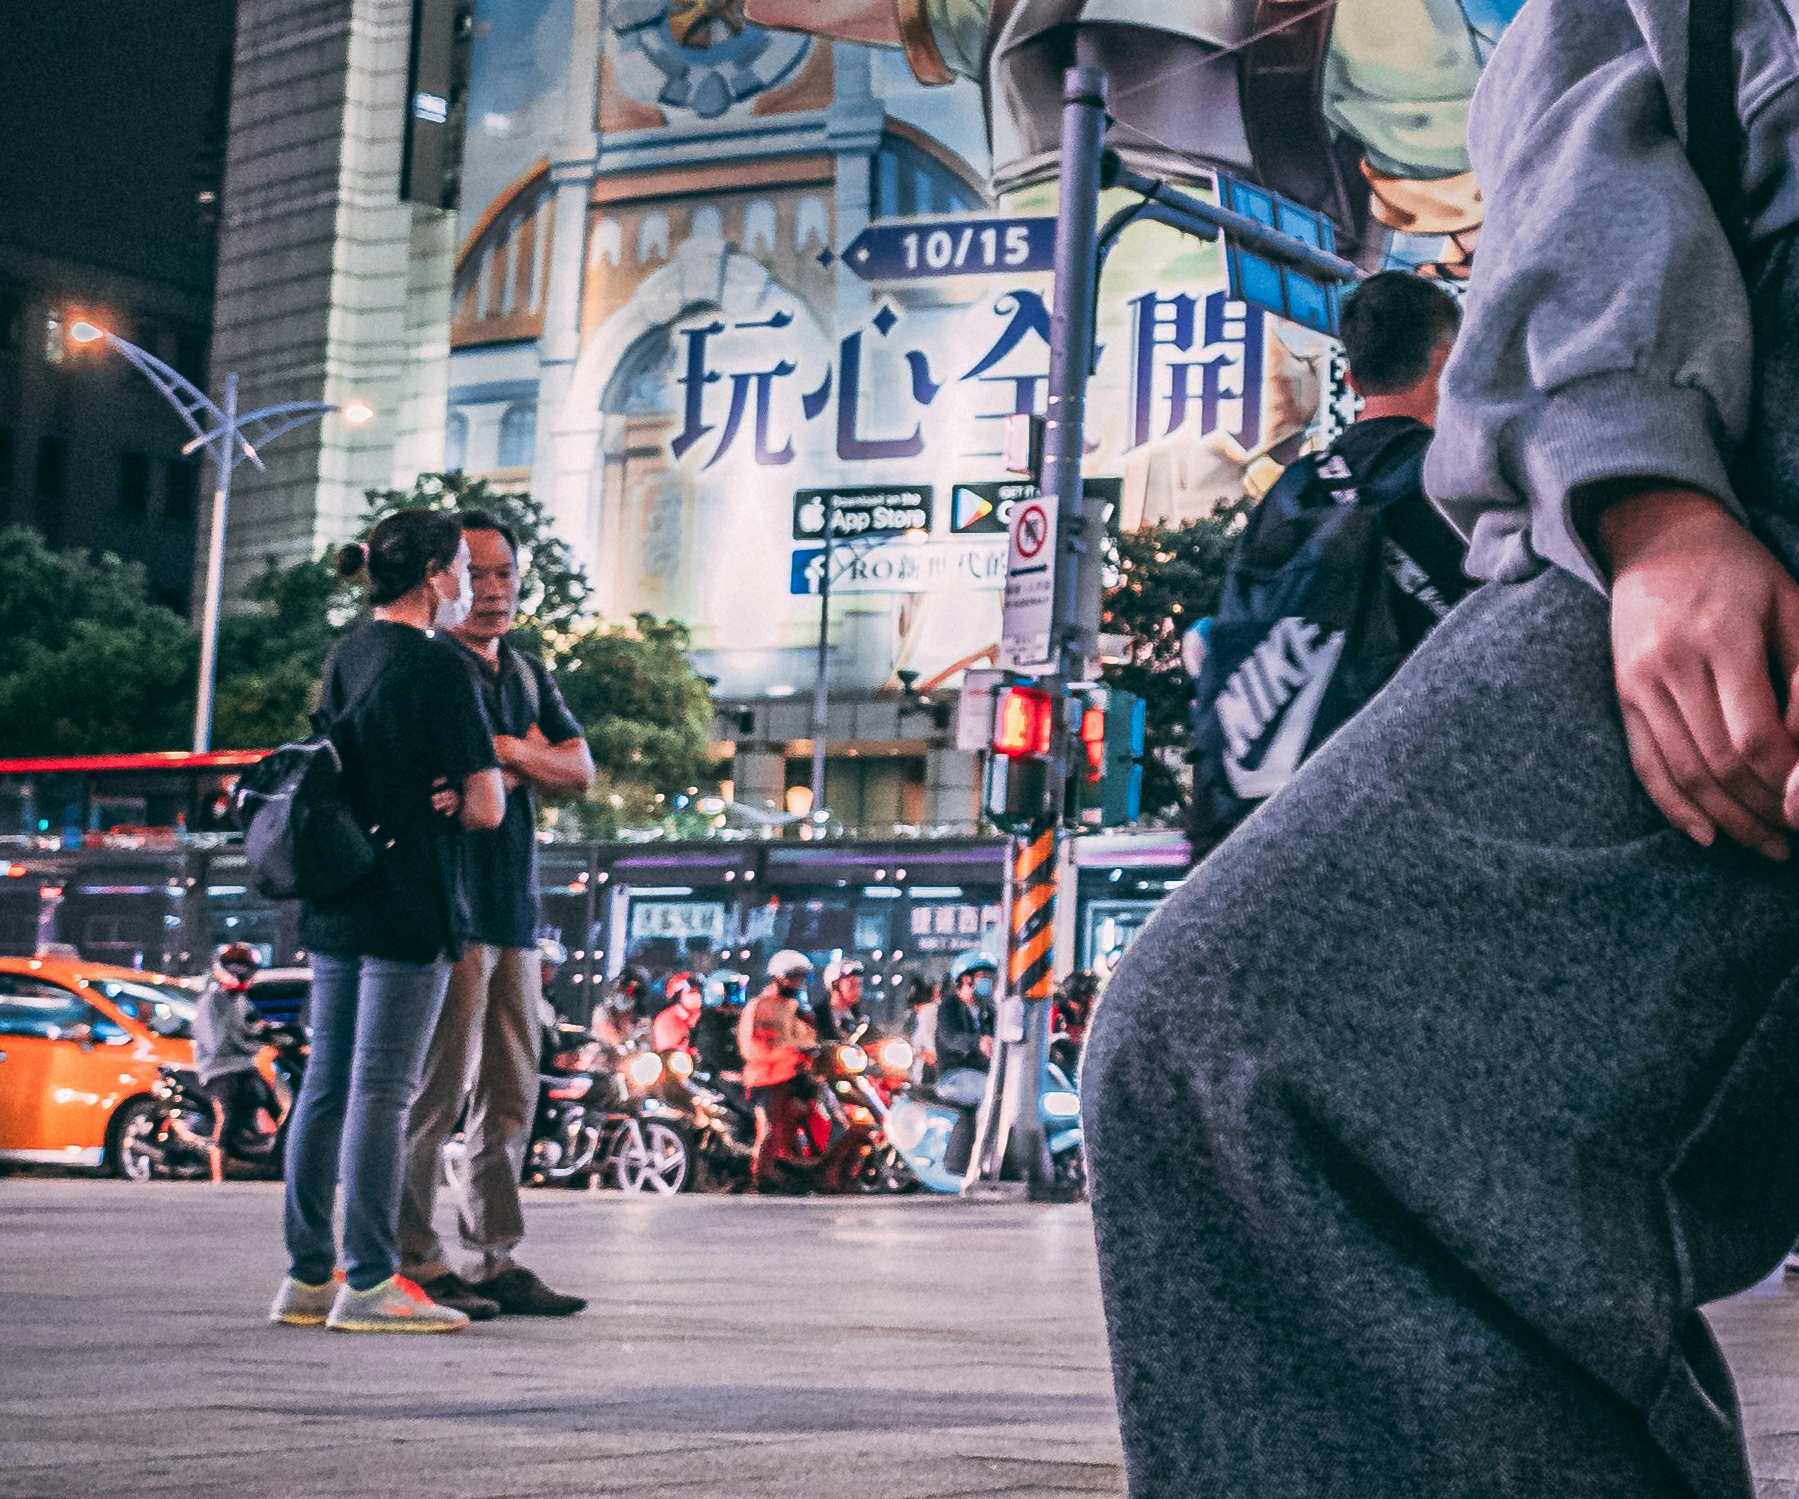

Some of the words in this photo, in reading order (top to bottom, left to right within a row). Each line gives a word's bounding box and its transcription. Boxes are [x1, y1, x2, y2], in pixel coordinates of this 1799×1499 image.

[902, 225, 1032, 270] 10/15
[831, 508, 871, 534] App
[872, 505, 926, 529] Store
[1215, 615, 1323, 762] NIKE
